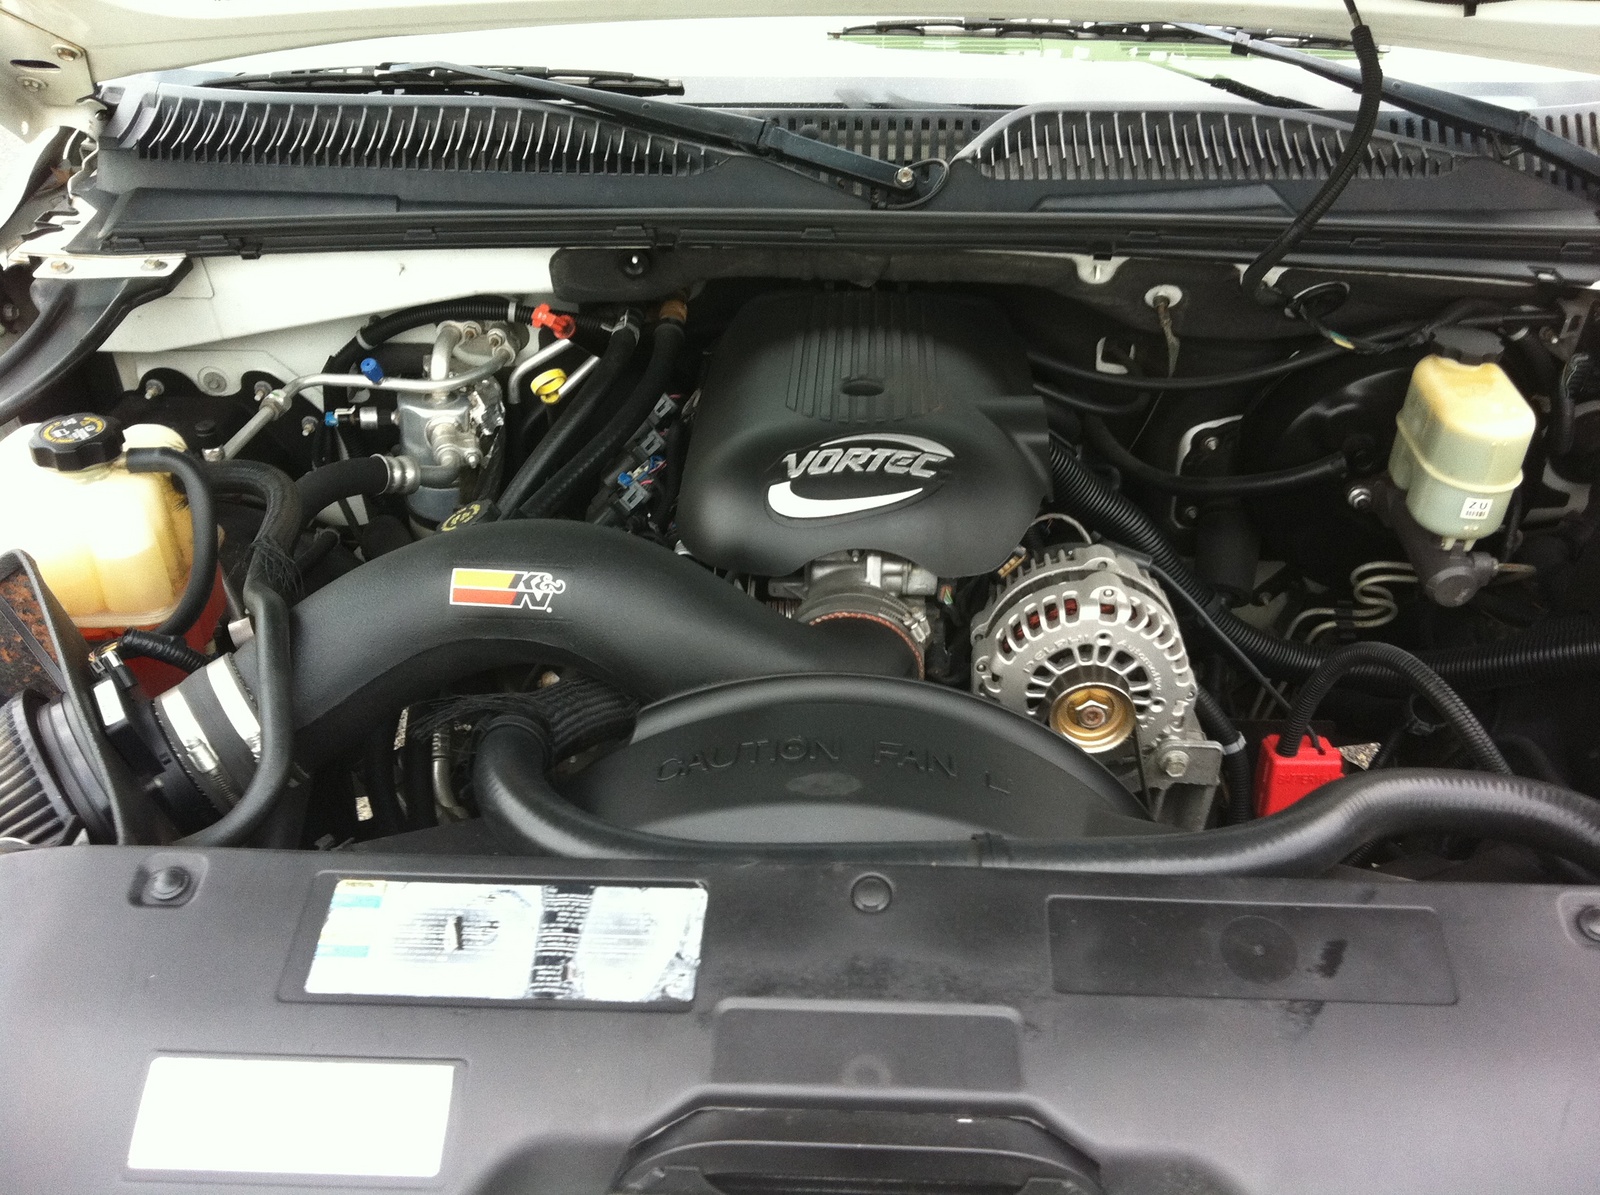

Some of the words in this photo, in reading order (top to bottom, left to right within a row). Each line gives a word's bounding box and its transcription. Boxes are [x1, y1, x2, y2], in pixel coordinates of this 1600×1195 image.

[782, 447, 947, 479] VORTEC
[508, 571, 566, 611] K&N
[656, 736, 839, 782] CAUTION
[874, 740, 957, 777] FAN
